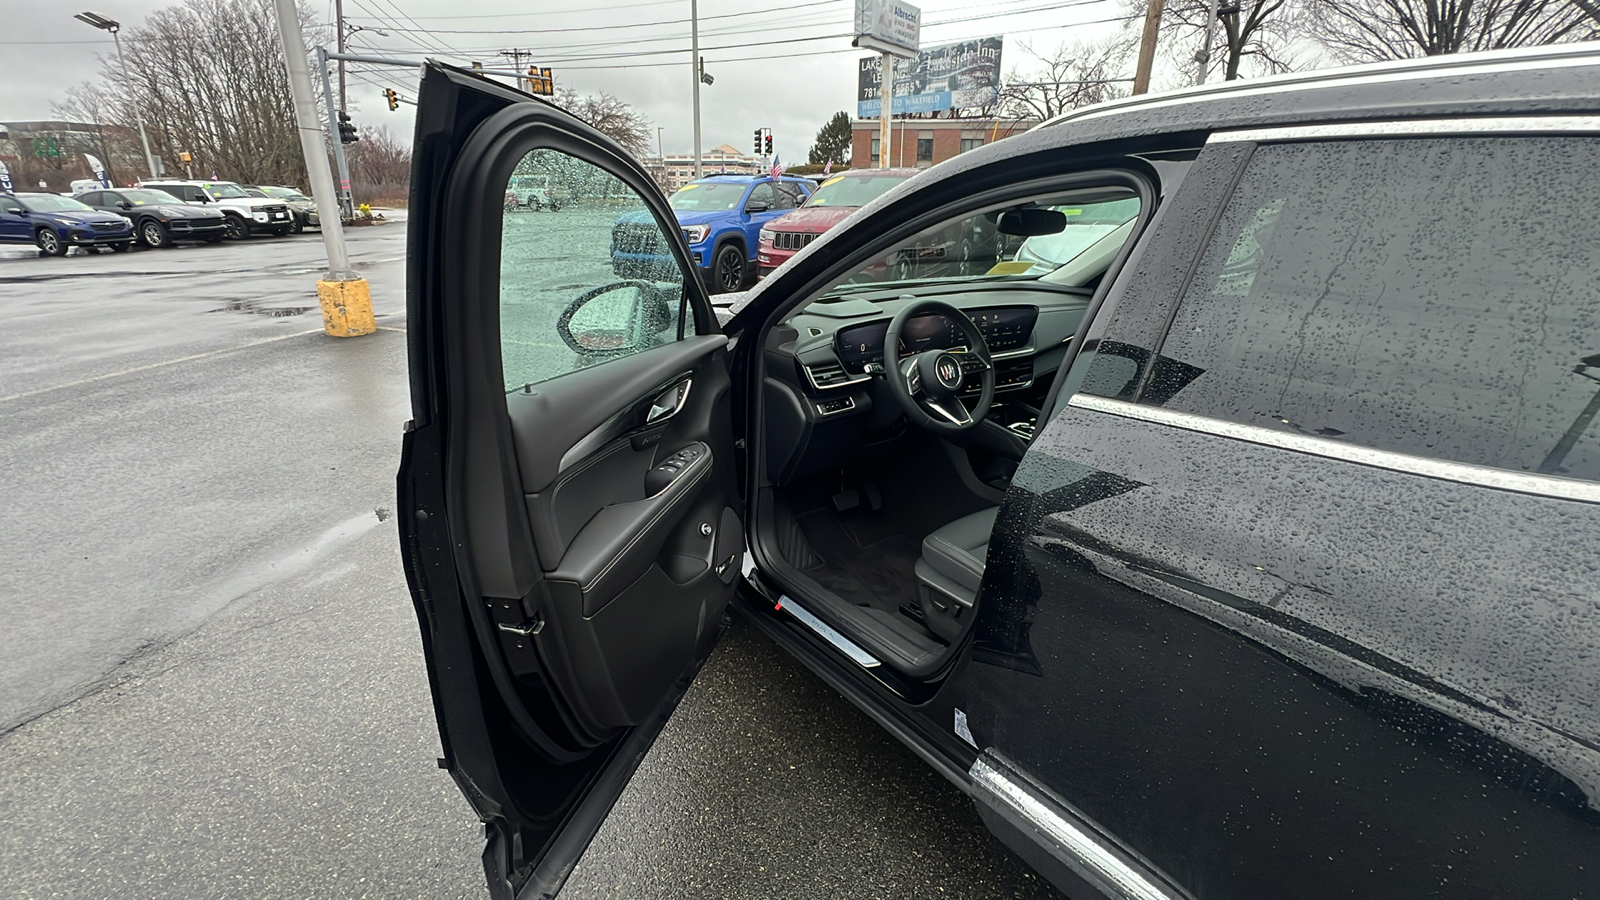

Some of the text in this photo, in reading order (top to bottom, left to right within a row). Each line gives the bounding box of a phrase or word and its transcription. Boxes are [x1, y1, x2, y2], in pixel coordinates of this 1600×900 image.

[894, 6, 916, 23] Albrecht
[927, 41, 996, 71] Lakeside Inn
[894, 98, 902, 107] TO
[905, 94, 940, 105] WAKEFIELD
